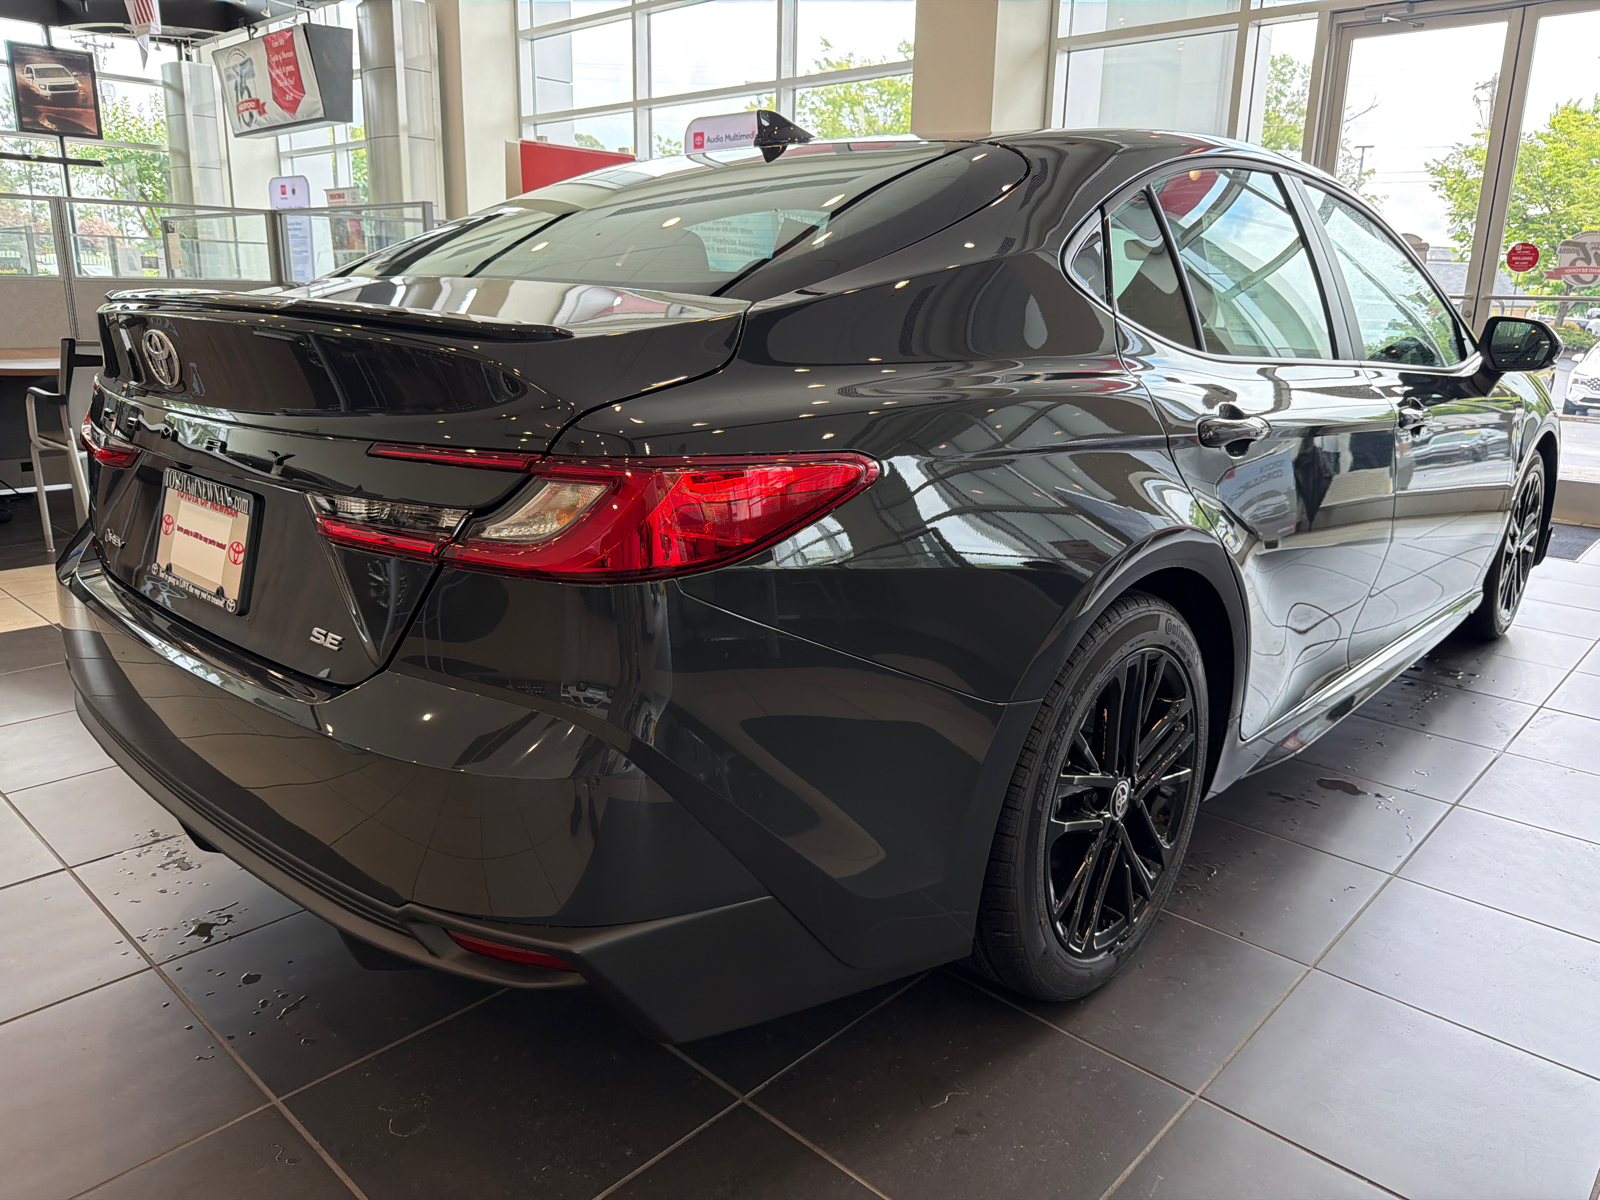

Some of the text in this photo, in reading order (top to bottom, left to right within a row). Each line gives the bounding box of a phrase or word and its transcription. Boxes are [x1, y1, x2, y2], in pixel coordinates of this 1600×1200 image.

[706, 134, 724, 144] Audio
[310, 627, 343, 651] SE
[1164, 618, 1197, 662] Continental
